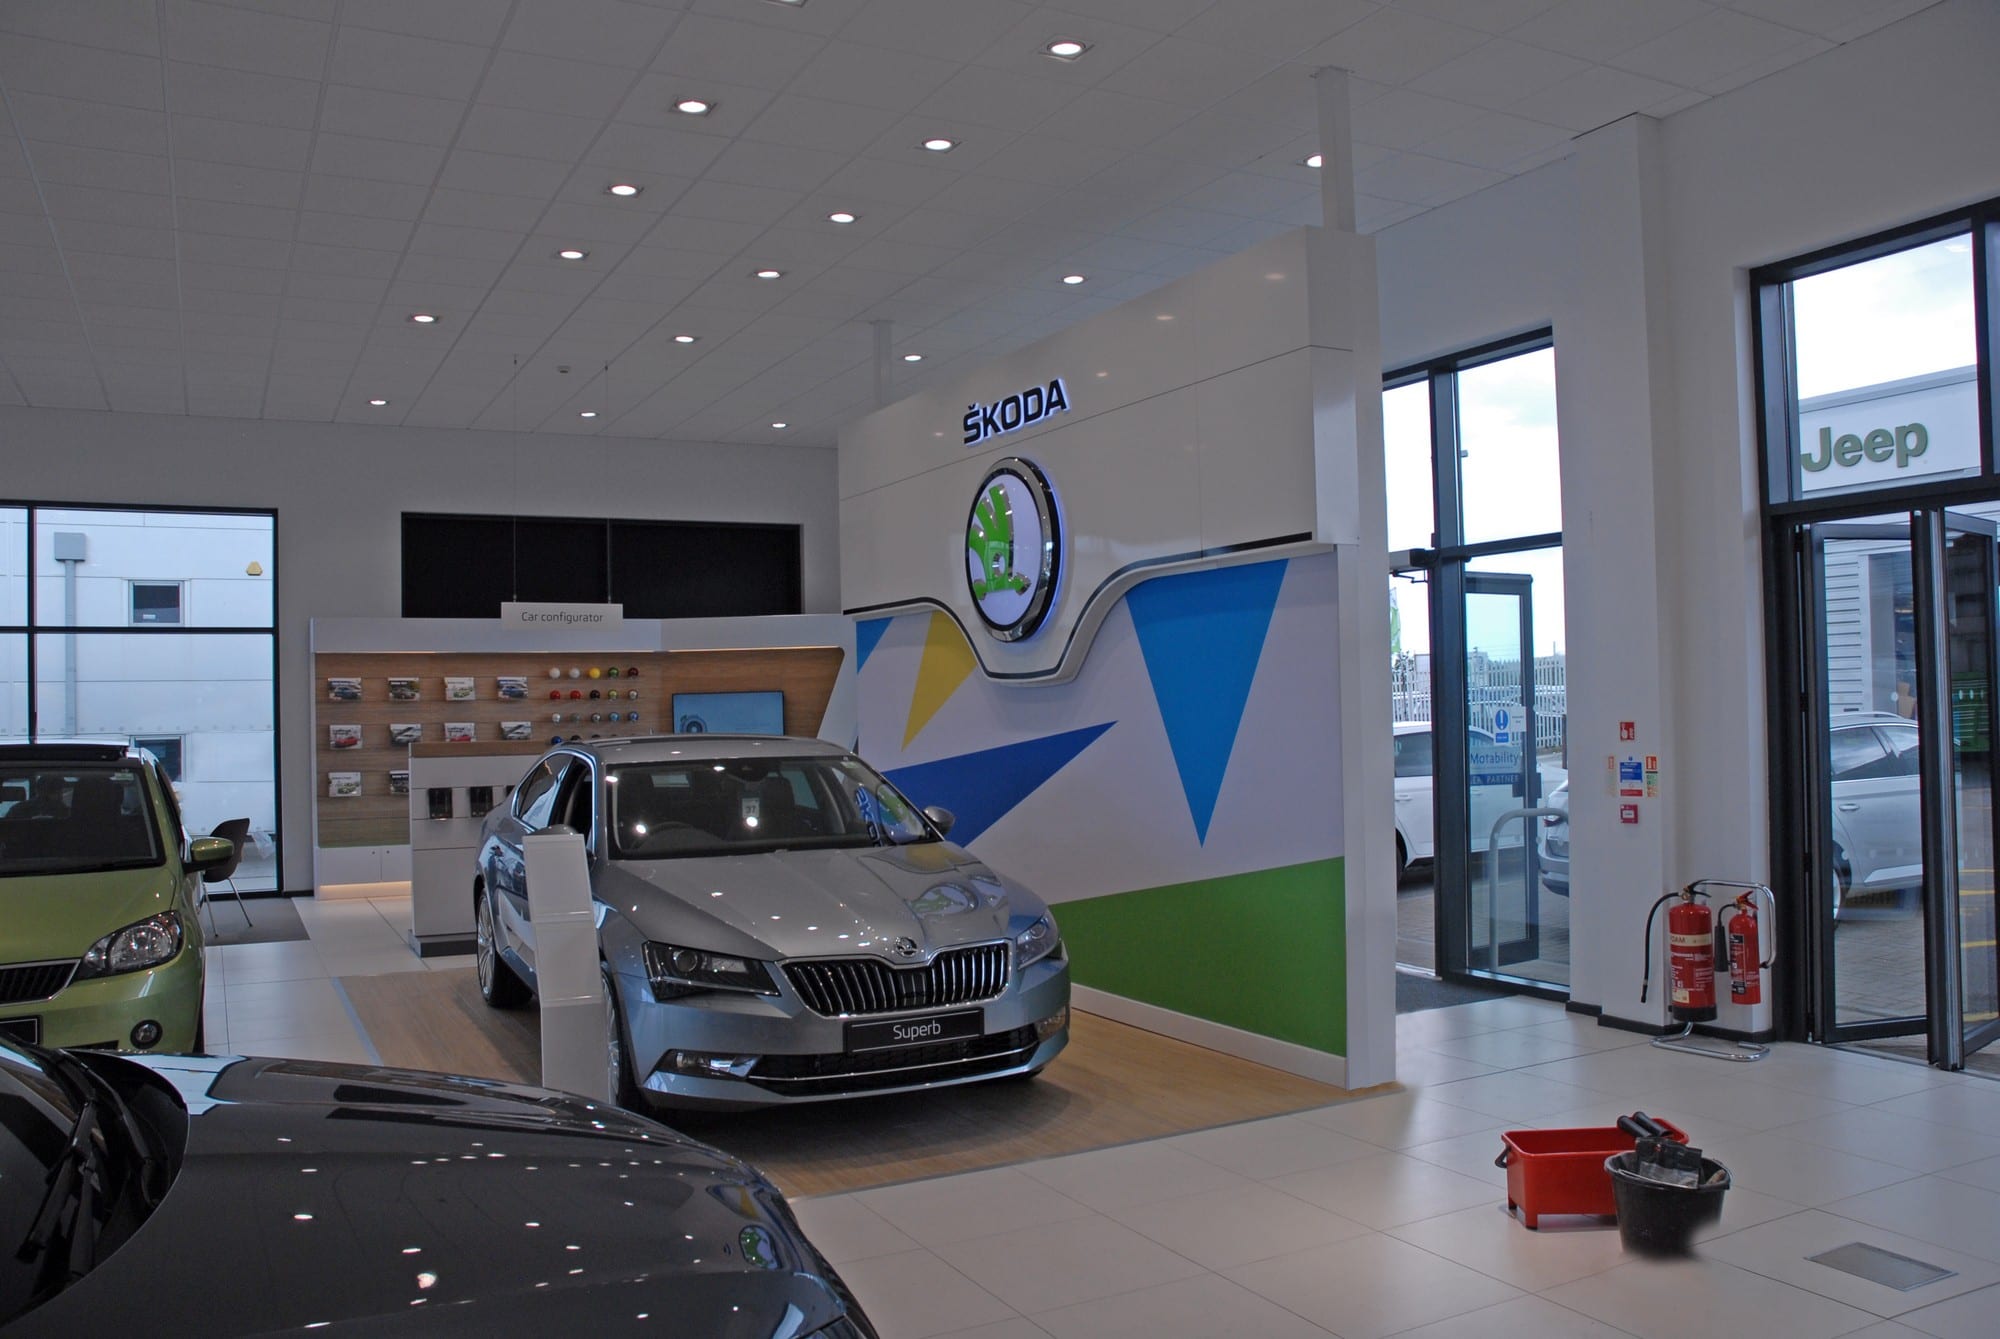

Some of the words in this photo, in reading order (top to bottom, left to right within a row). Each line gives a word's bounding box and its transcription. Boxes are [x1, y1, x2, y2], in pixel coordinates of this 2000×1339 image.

[963, 379, 1068, 444] ŠKODA
[1800, 423, 1928, 472] Jeep
[521, 612, 538, 622] Car
[541, 612, 603, 624] configurator
[1470, 752, 1519, 766] Motability
[893, 1020, 941, 1040] Superb
